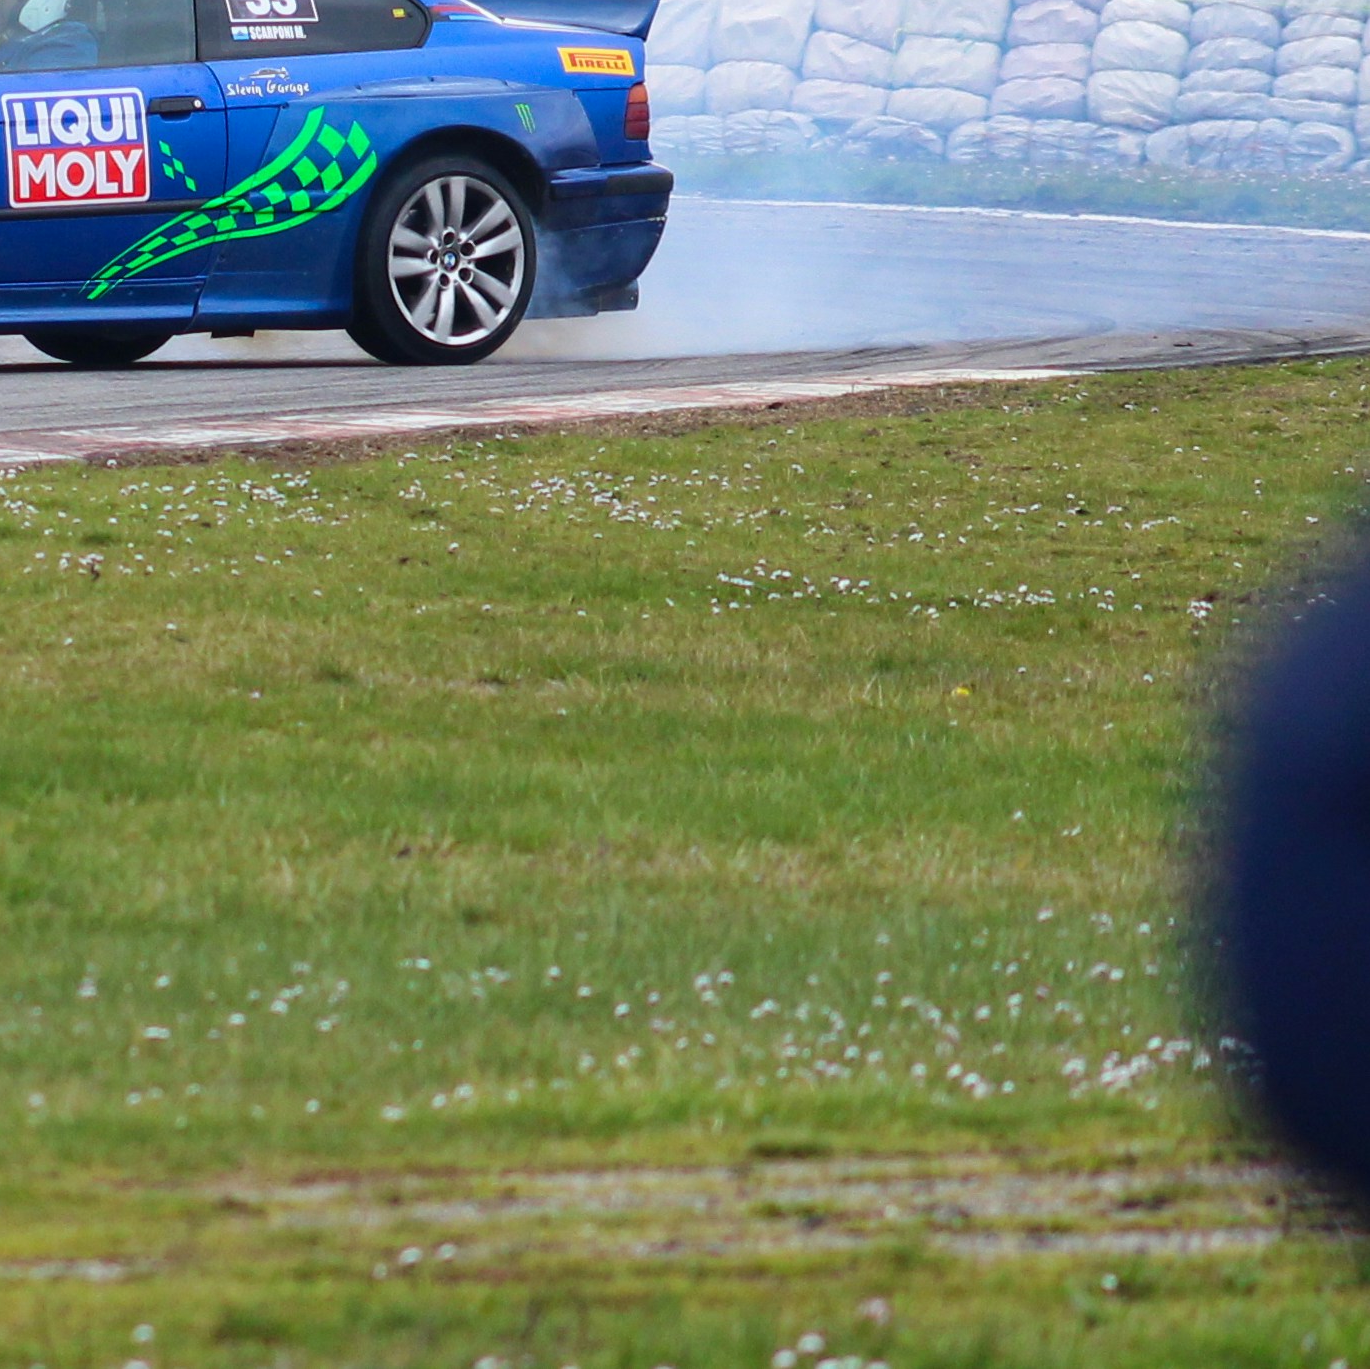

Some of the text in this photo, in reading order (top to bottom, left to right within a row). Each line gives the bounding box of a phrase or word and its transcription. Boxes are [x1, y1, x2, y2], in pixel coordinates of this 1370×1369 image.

[249, 25, 295, 40] SCARPONI
[568, 53, 627, 71] PIRELLI
[266, 79, 310, 96] Garage
[12, 96, 138, 146] LIQUI
[18, 149, 143, 199] MOLY
